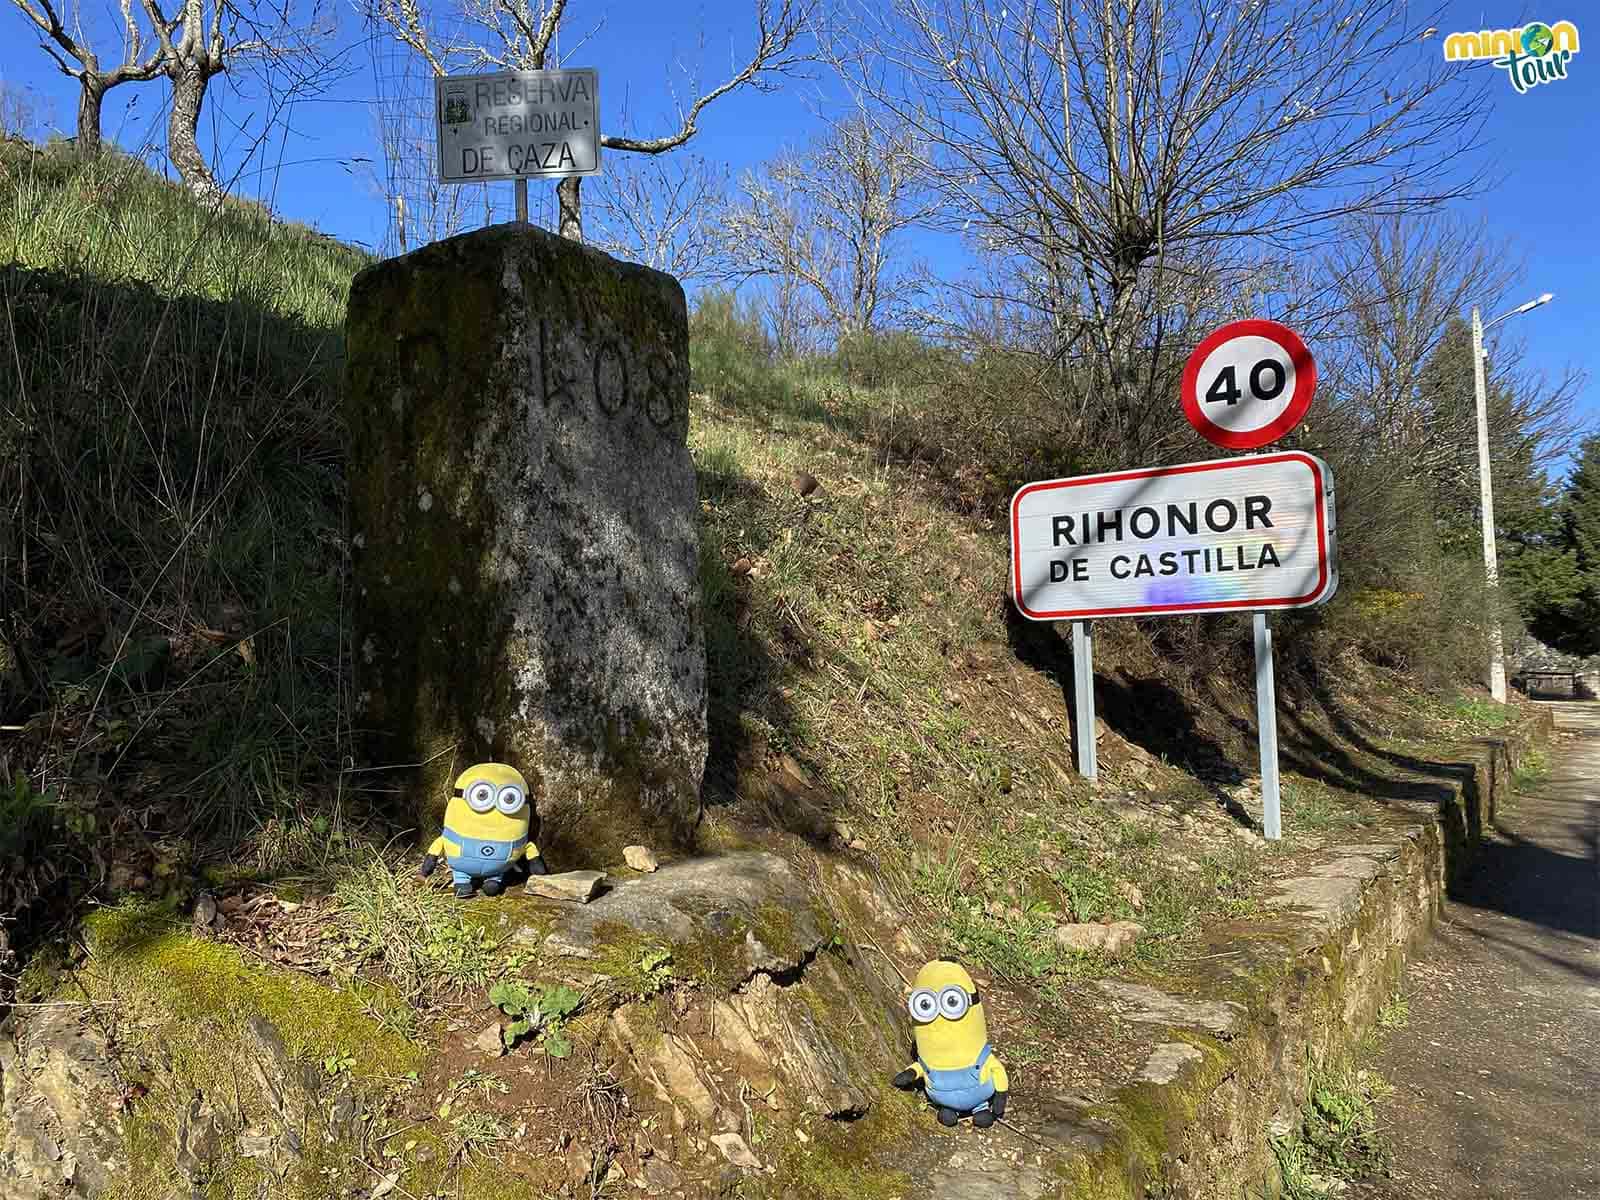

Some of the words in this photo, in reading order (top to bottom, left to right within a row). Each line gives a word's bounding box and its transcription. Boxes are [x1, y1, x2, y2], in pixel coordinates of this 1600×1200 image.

[474, 76, 590, 107] RESERVA
[484, 112, 581, 136] REGIONAL
[462, 146, 495, 174] DE
[507, 142, 577, 171] CAZA
[1205, 358, 1286, 405] 40
[1052, 495, 1274, 547] RIHONOR
[1050, 558, 1089, 583] DE
[1110, 543, 1281, 579] CASTILLA
